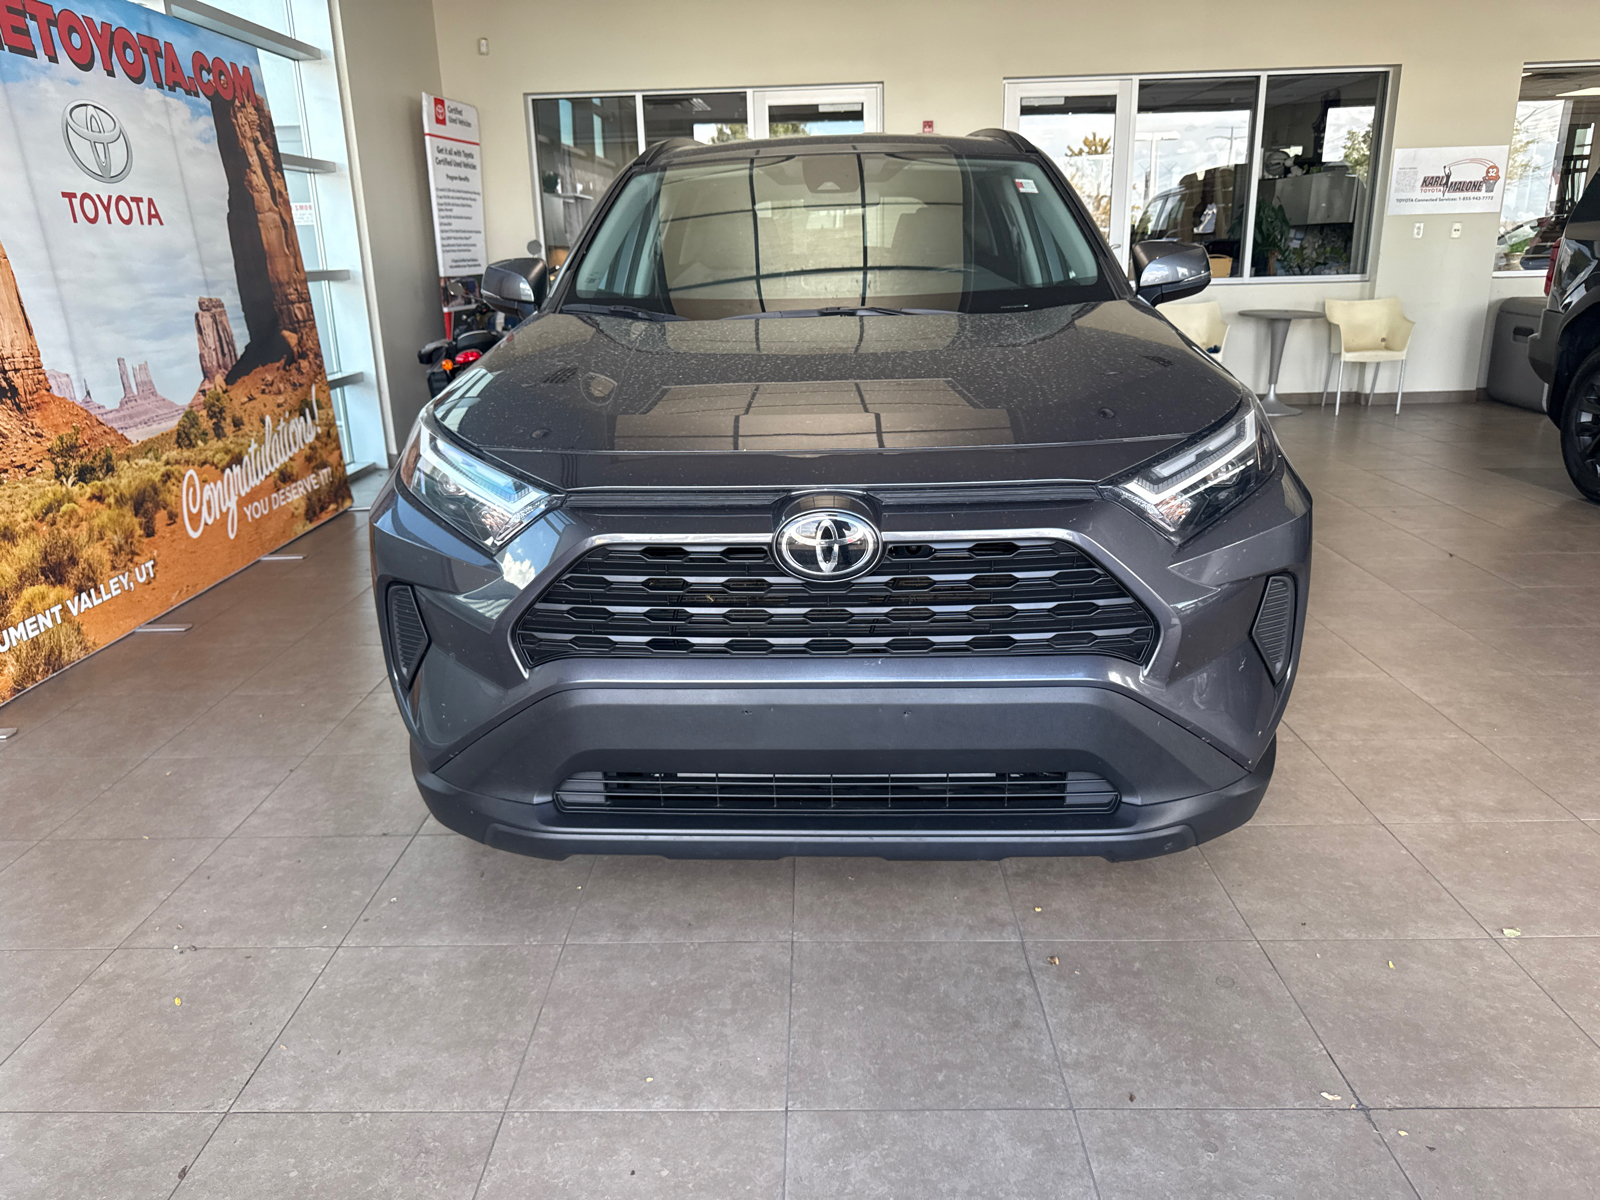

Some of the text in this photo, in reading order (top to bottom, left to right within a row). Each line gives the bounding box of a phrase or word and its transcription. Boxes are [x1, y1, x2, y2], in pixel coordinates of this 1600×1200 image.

[435, 156, 453, 167] Certified
[453, 159, 463, 169] Used
[436, 145, 444, 154] Get
[462, 149, 475, 160] Toyota
[1420, 176, 1484, 193] KARL MALONE
[1487, 168, 1497, 176] 32
[61, 191, 164, 226] TOYOTA
[182, 384, 321, 540] Congratulations!
[243, 467, 333, 522] YOU DESERVE IT!
[66, 571, 135, 617] VALLEY,
[136, 559, 155, 587] UT
